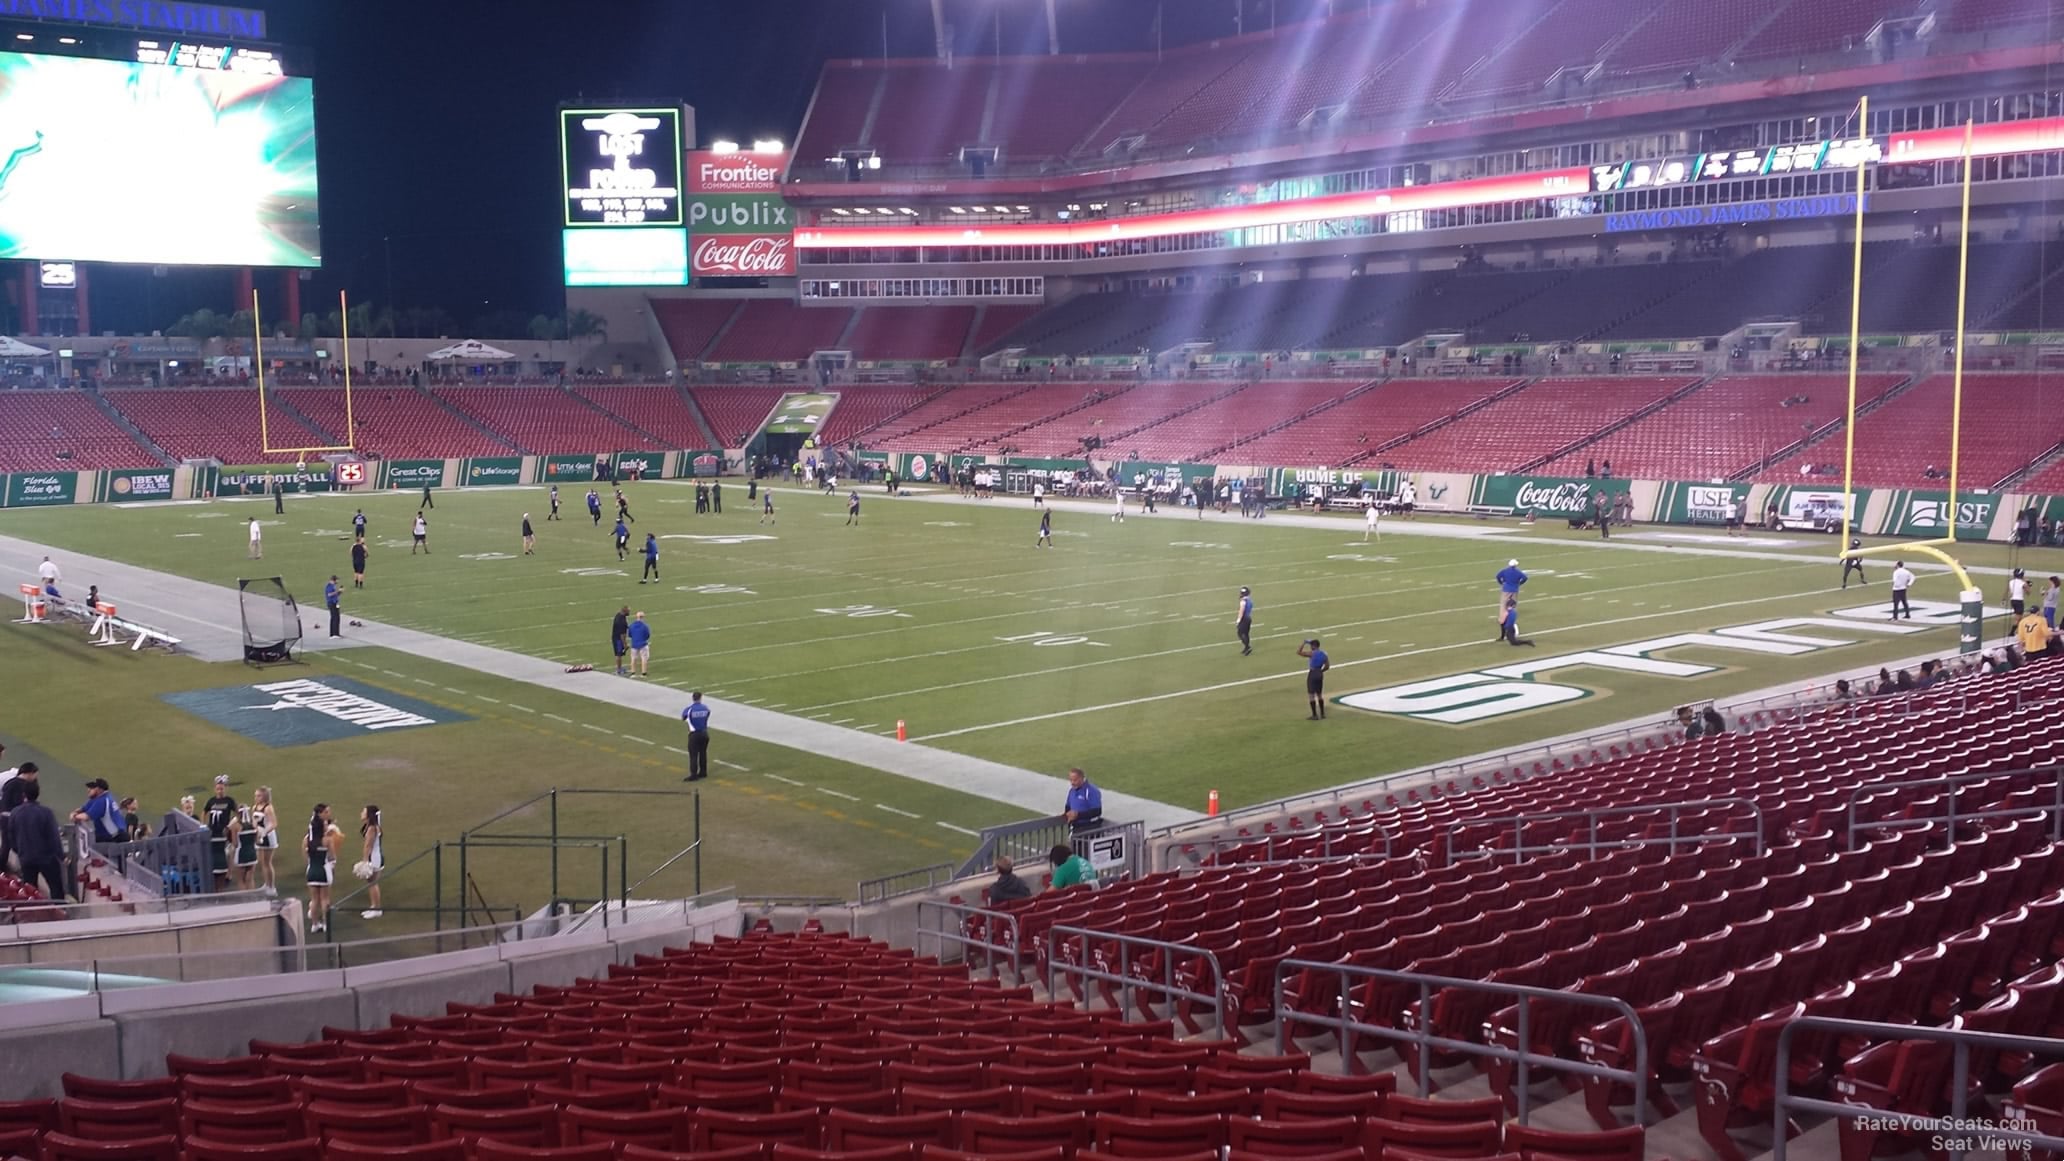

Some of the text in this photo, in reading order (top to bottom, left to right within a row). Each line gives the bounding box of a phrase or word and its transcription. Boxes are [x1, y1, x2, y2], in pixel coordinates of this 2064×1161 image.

[701, 161, 778, 182] Frontier
[702, 182, 775, 190] COMMUNICATIONS
[690, 202, 787, 226] Publix
[1605, 195, 1870, 233] RAYMOND JAMES STADIUM
[41, 263, 75, 285] 25
[342, 464, 361, 480] 25
[390, 466, 441, 477] Great Clips
[1296, 470, 1337, 483] HOME
[23, 475, 59, 485] Florida
[131, 475, 169, 484] IBEW
[24, 485, 44, 494] Blue
[1692, 488, 1731, 507] USF
[1939, 502, 1991, 524] USF
[993, 631, 1089, 646] 10
